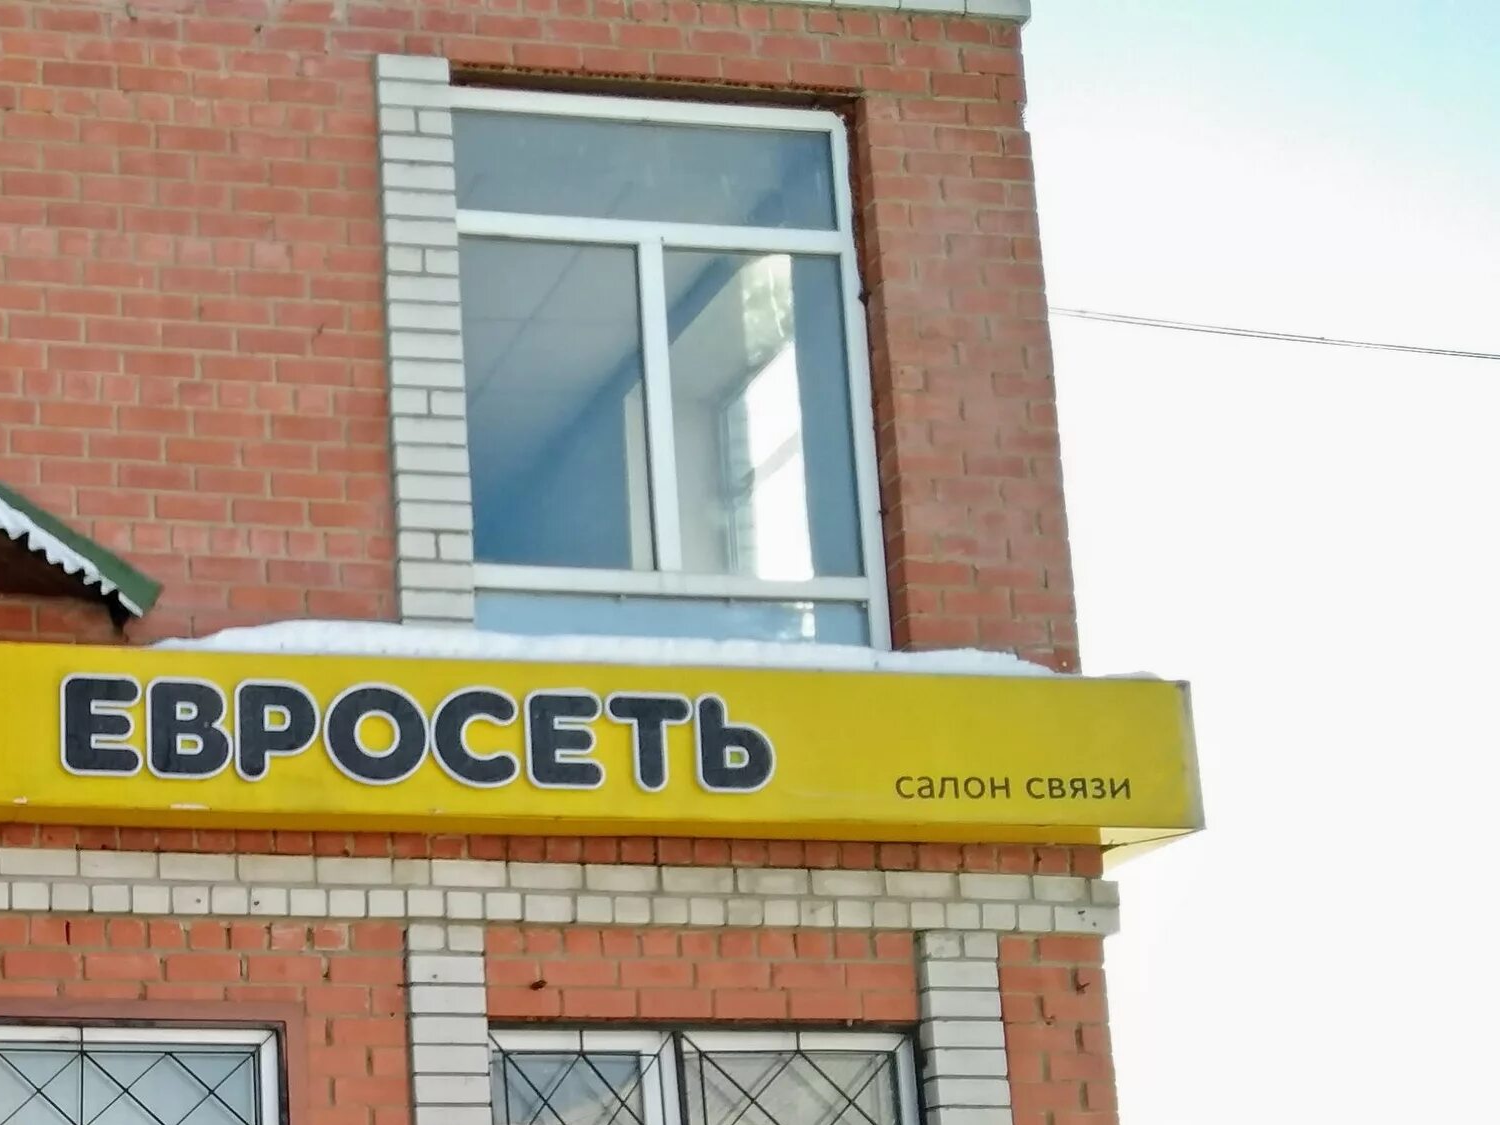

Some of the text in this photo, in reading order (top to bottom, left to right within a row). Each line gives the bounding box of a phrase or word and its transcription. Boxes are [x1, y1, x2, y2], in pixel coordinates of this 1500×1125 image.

[60, 673, 775, 793] ЕВРОСЕТЬ
[895, 775, 1132, 800] салон связи
